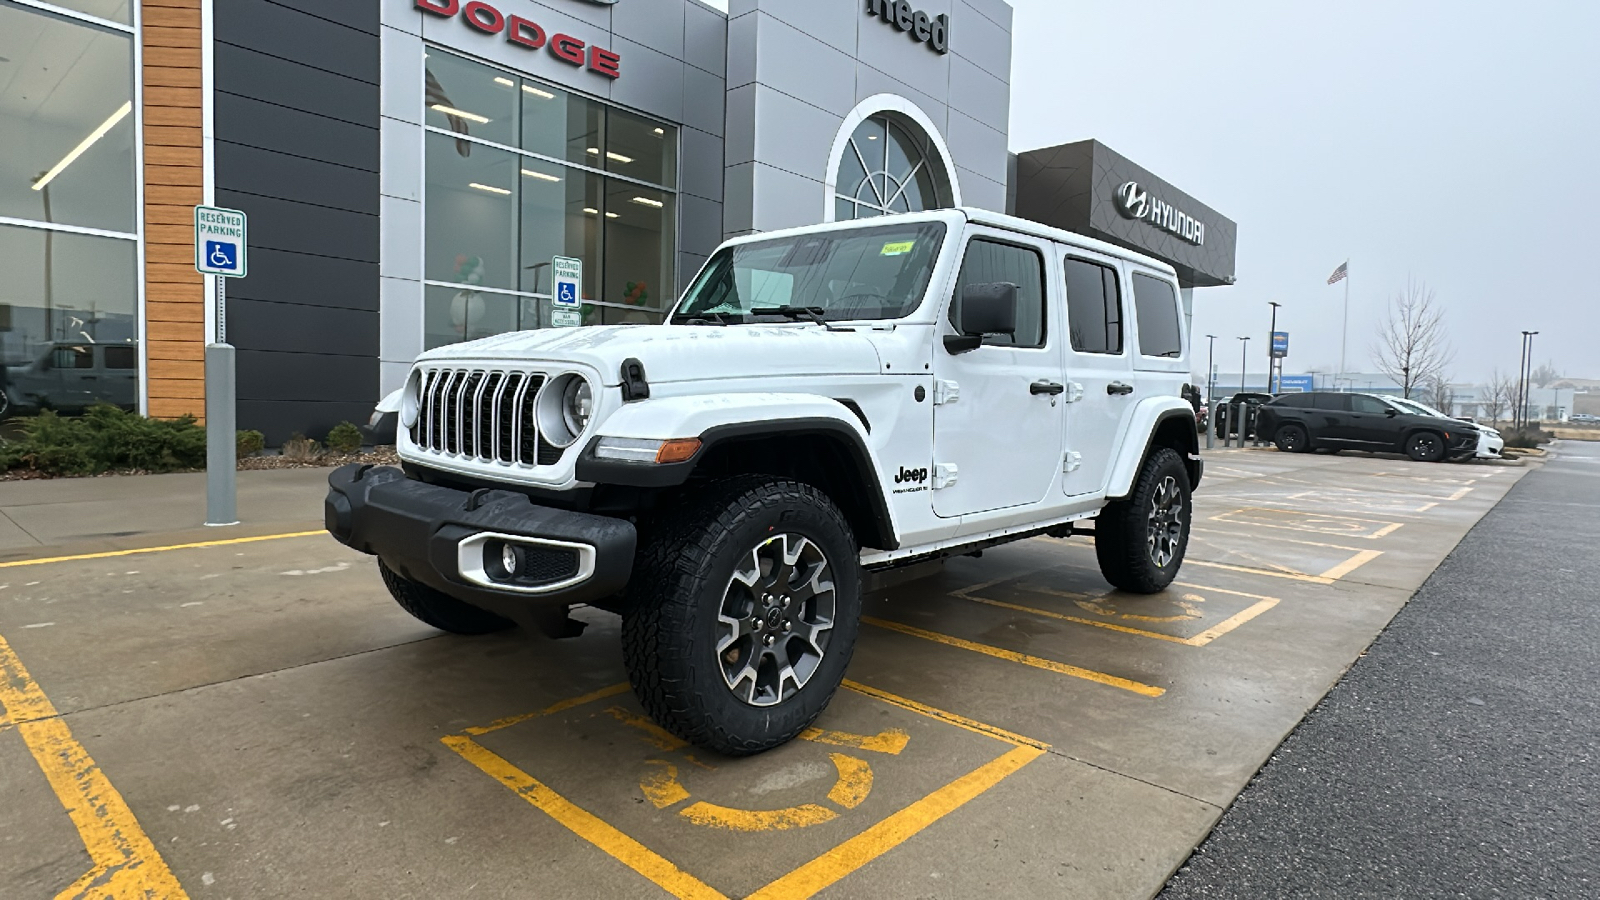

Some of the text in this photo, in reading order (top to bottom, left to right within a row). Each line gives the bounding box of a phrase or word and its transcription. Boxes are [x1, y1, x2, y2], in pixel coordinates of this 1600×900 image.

[200, 212, 241, 226] RESERVED
[1151, 196, 1205, 246] HYUNDAI
[200, 223, 242, 237] PARKING
[556, 261, 579, 271] RESERVED
[555, 269, 579, 279] PARKING
[894, 466, 928, 484] Jeep
